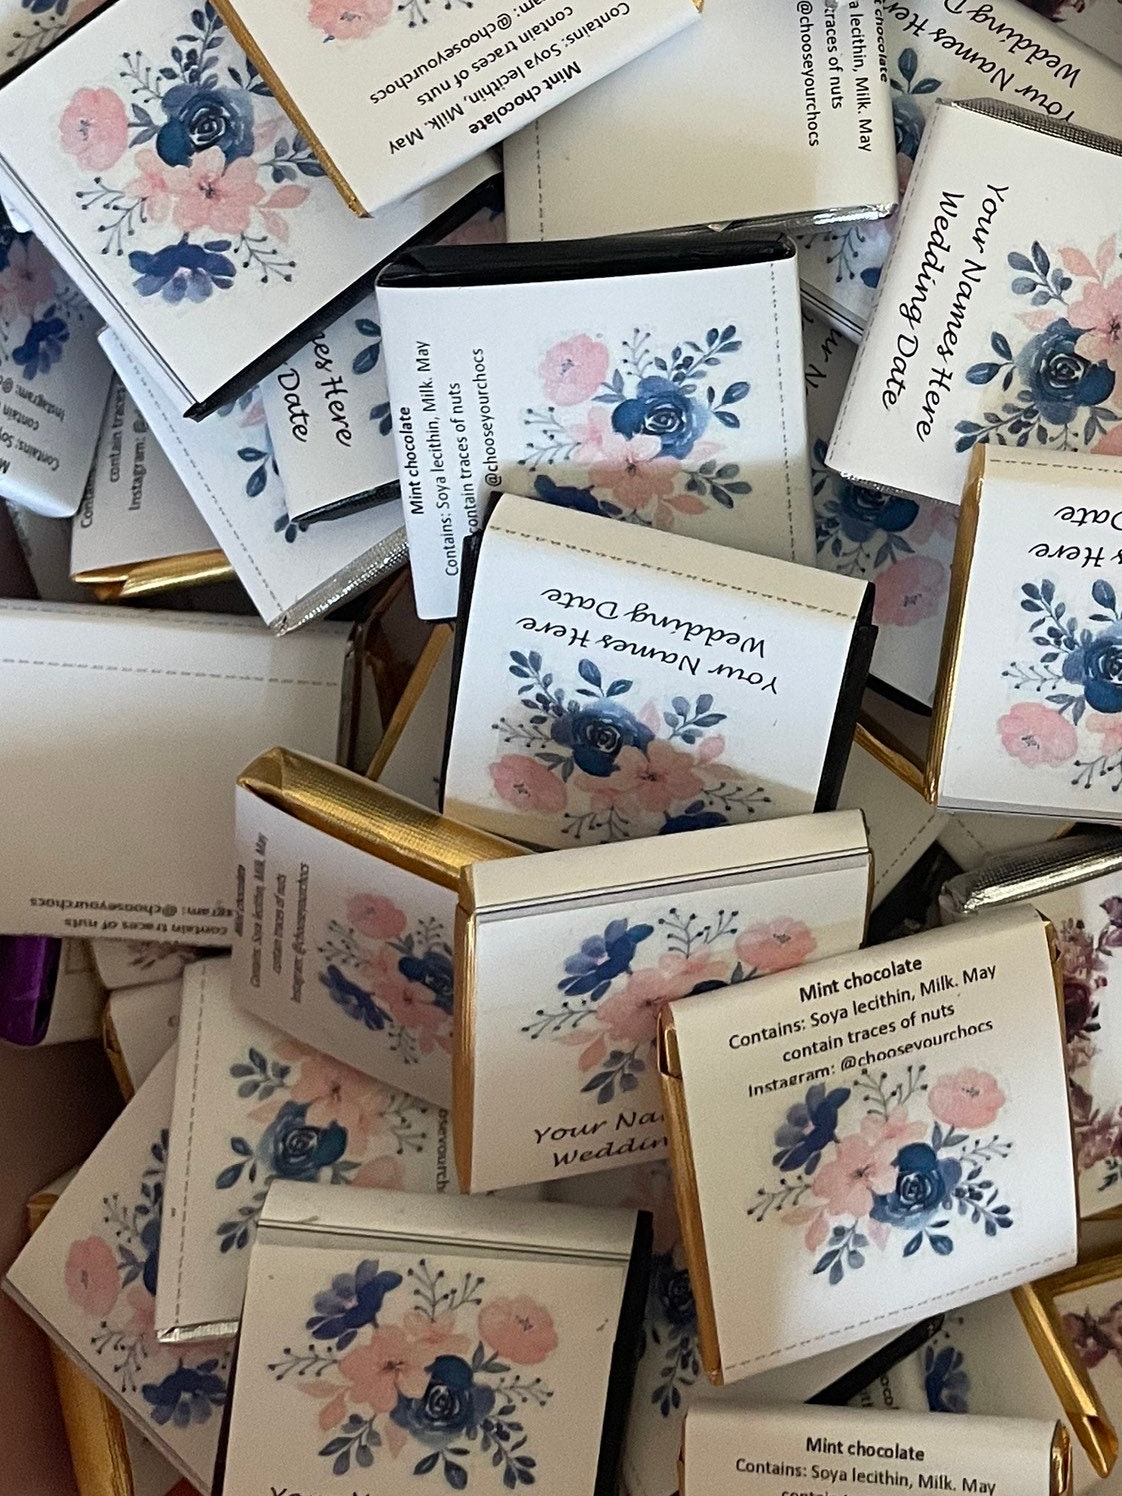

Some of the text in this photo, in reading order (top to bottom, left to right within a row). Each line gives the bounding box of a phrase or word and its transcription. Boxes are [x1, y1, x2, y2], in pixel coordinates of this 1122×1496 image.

[369, 12, 513, 104] @chooseyourchocs
[389, 2, 630, 155] Contains: Soya lecithin, Milk. May
[416, 6, 573, 106] contain traces of nuts
[966, 3, 1081, 89] Wedding
[468, 60, 582, 134] Mint chocolate
[882, 191, 965, 410] Wedding Date
[916, 184, 1009, 443] Your Names Here
[398, 406, 425, 515] Mint chocolate
[1028, 543, 1105, 568] Here
[515, 617, 777, 695] Your Names Here
[540, 588, 765, 659] Wedding Date
[728, 965, 996, 1050] Contains: Soya lecithin, Milk. May
[799, 959, 923, 1003] Mint chocolate
[806, 1436, 925, 1462] Mint chocolate
